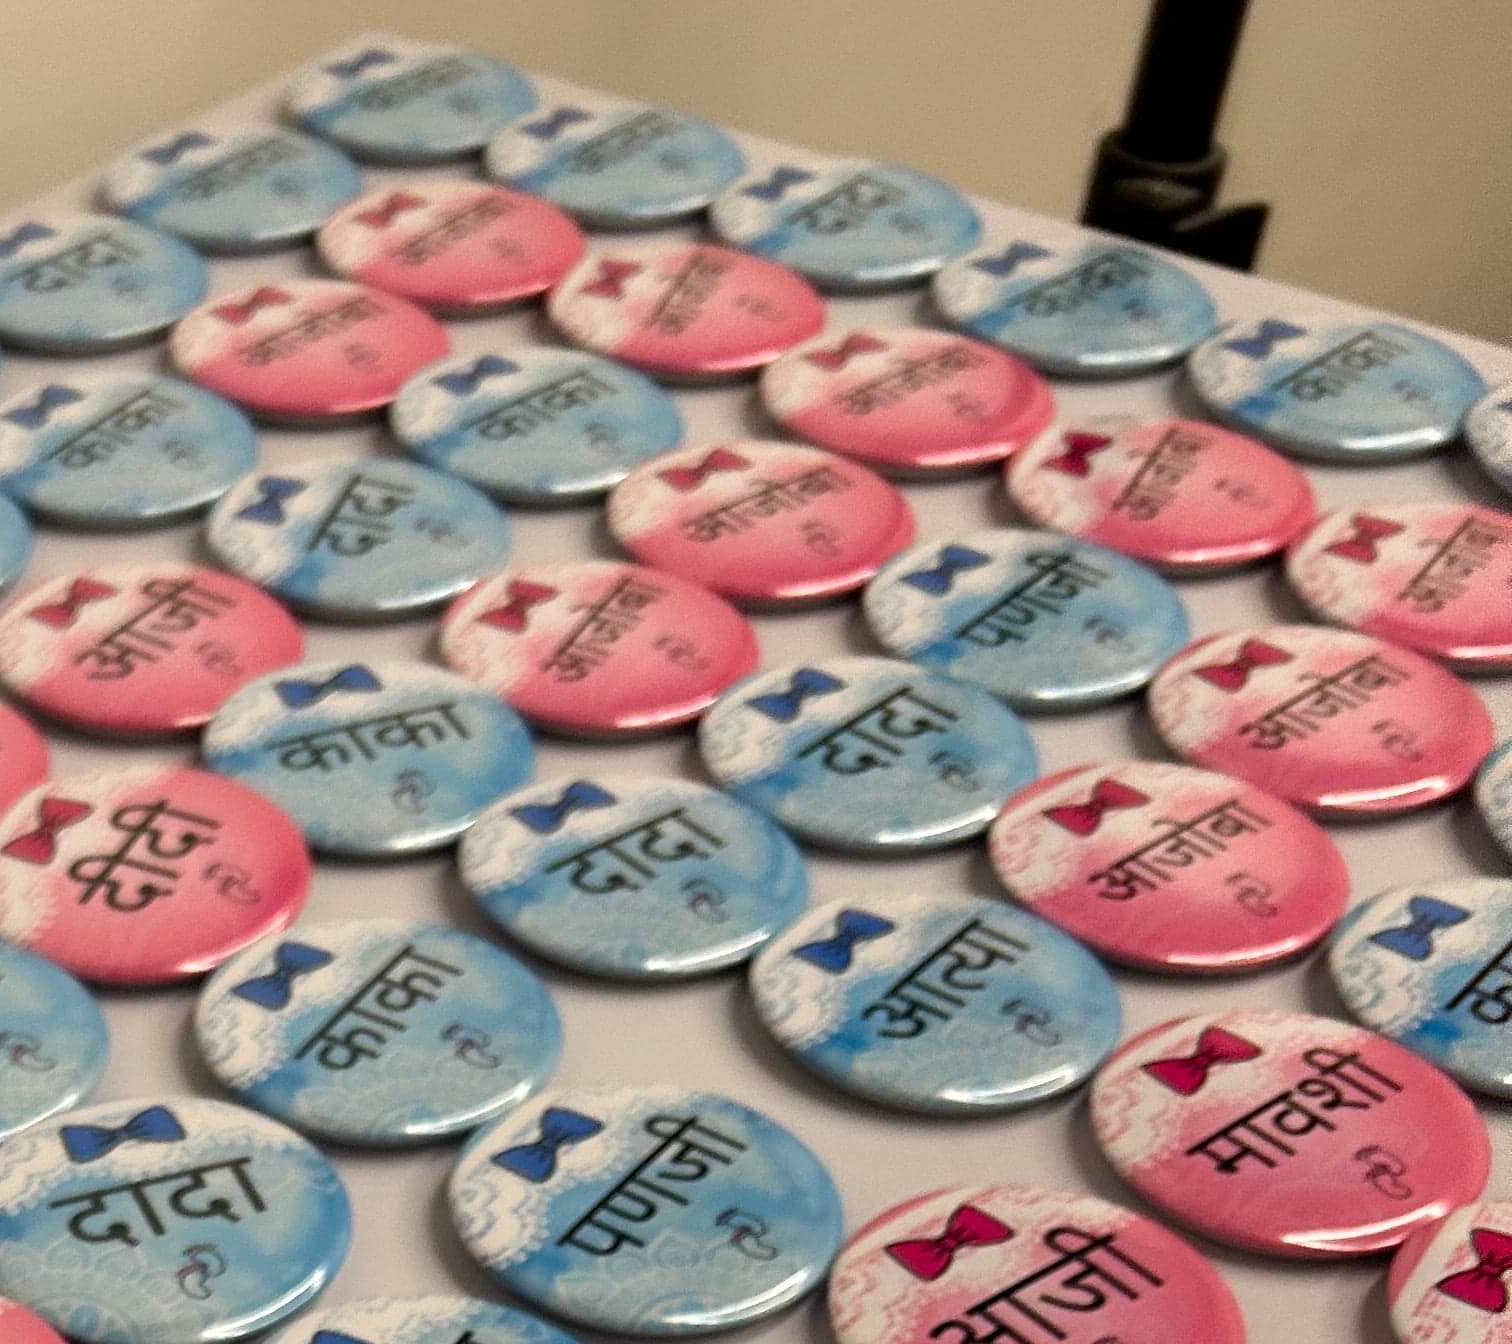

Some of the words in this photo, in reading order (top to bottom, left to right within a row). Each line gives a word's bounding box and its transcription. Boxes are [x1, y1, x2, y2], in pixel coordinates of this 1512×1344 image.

[42, 386, 176, 471] काका
[456, 366, 622, 441] काका
[306, 474, 417, 556] दादा
[79, 577, 229, 681] आजी
[953, 546, 1109, 646] पणजी
[262, 702, 473, 772] काका
[796, 686, 959, 777] दादा
[1240, 655, 1409, 752] आजोबा
[69, 800, 223, 913] दीदी
[544, 807, 726, 896] दादा
[1090, 799, 1271, 902] आजोबा
[293, 946, 465, 1072] काका
[862, 918, 1032, 1043] आत्या
[1187, 1046, 1405, 1174] मावशी
[49, 1157, 270, 1248] दादा
[558, 1113, 749, 1258] पणजी
